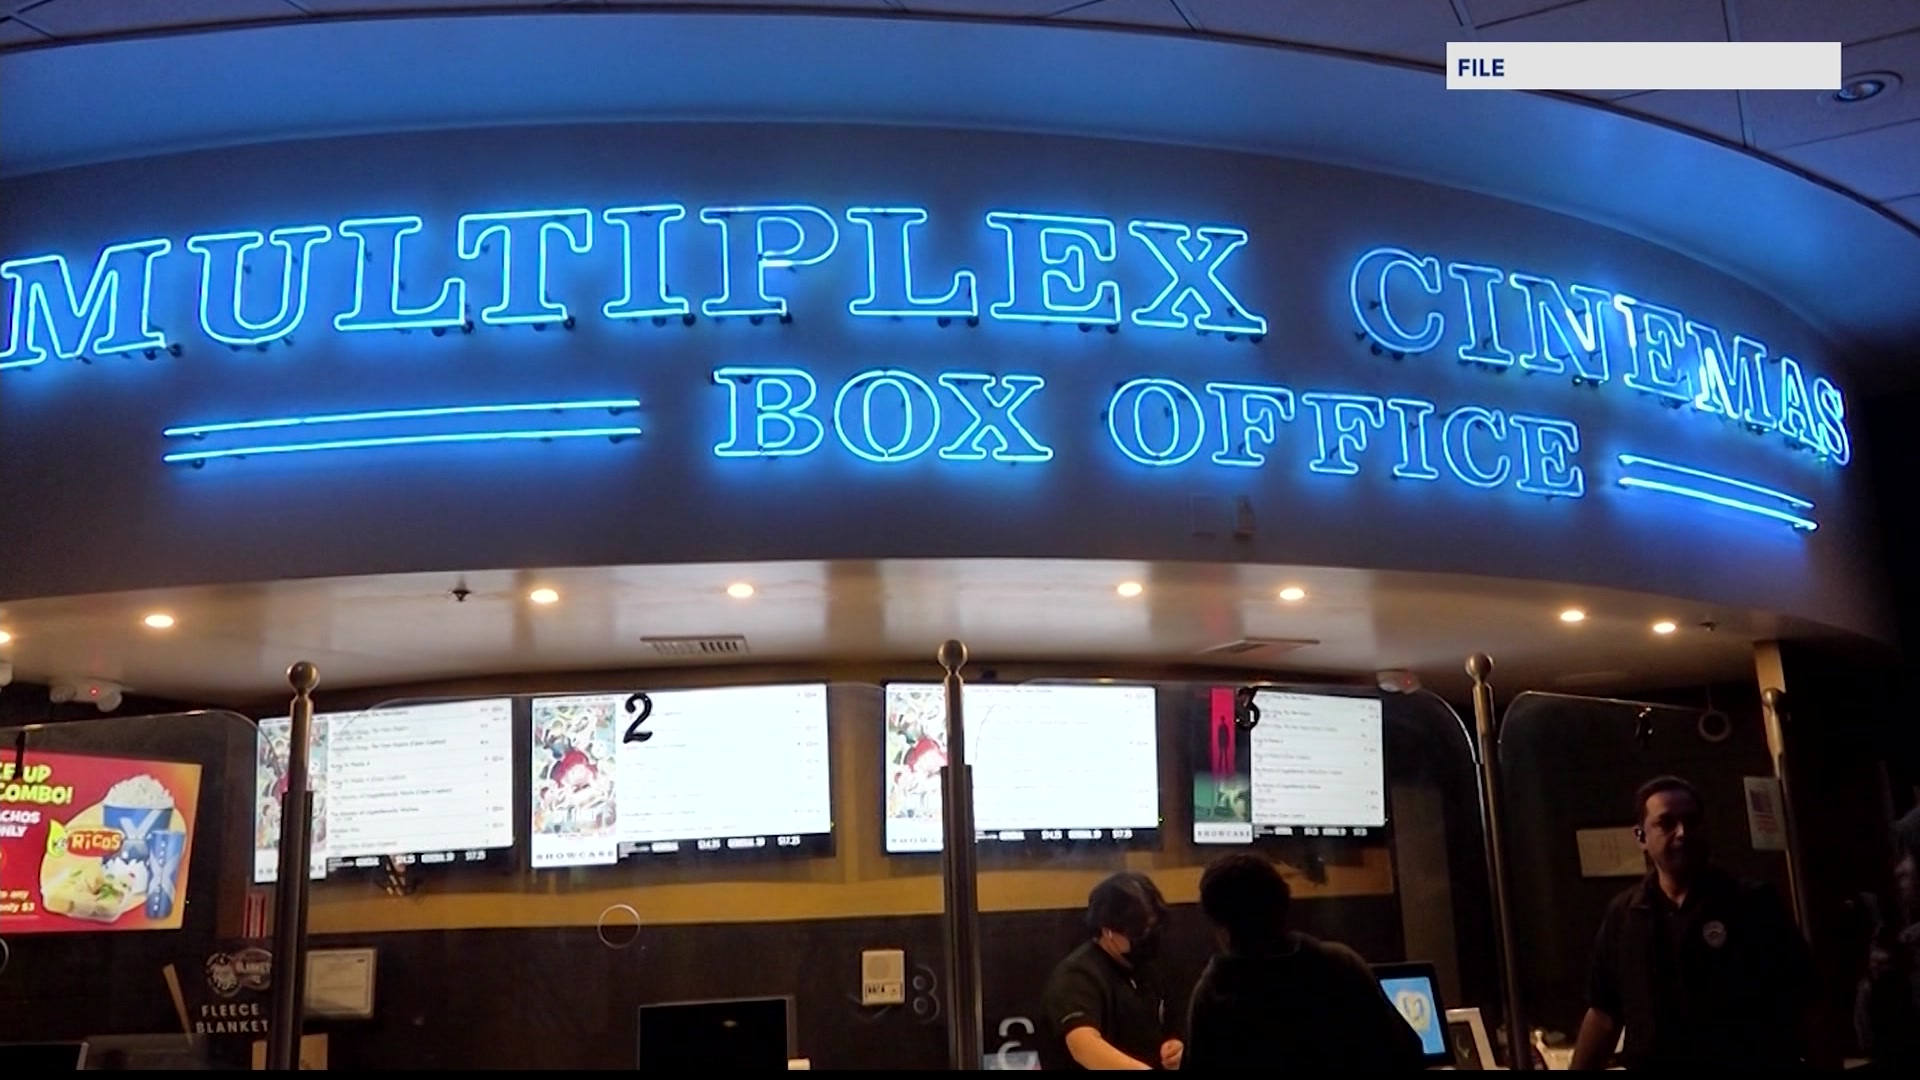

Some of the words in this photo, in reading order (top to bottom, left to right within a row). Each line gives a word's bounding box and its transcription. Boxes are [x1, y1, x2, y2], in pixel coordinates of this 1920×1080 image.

[0, 203, 1267, 369] MULTIPLEX
[1350, 246, 1850, 466] CINEMAS
[712, 366, 1054, 463] BOX
[1107, 377, 1586, 497] OFFICE
[623, 692, 653, 744] 2
[23, 764, 52, 783] UP
[195, 1020, 269, 1034] BLANKET
[201, 1003, 260, 1017] FLEECE
